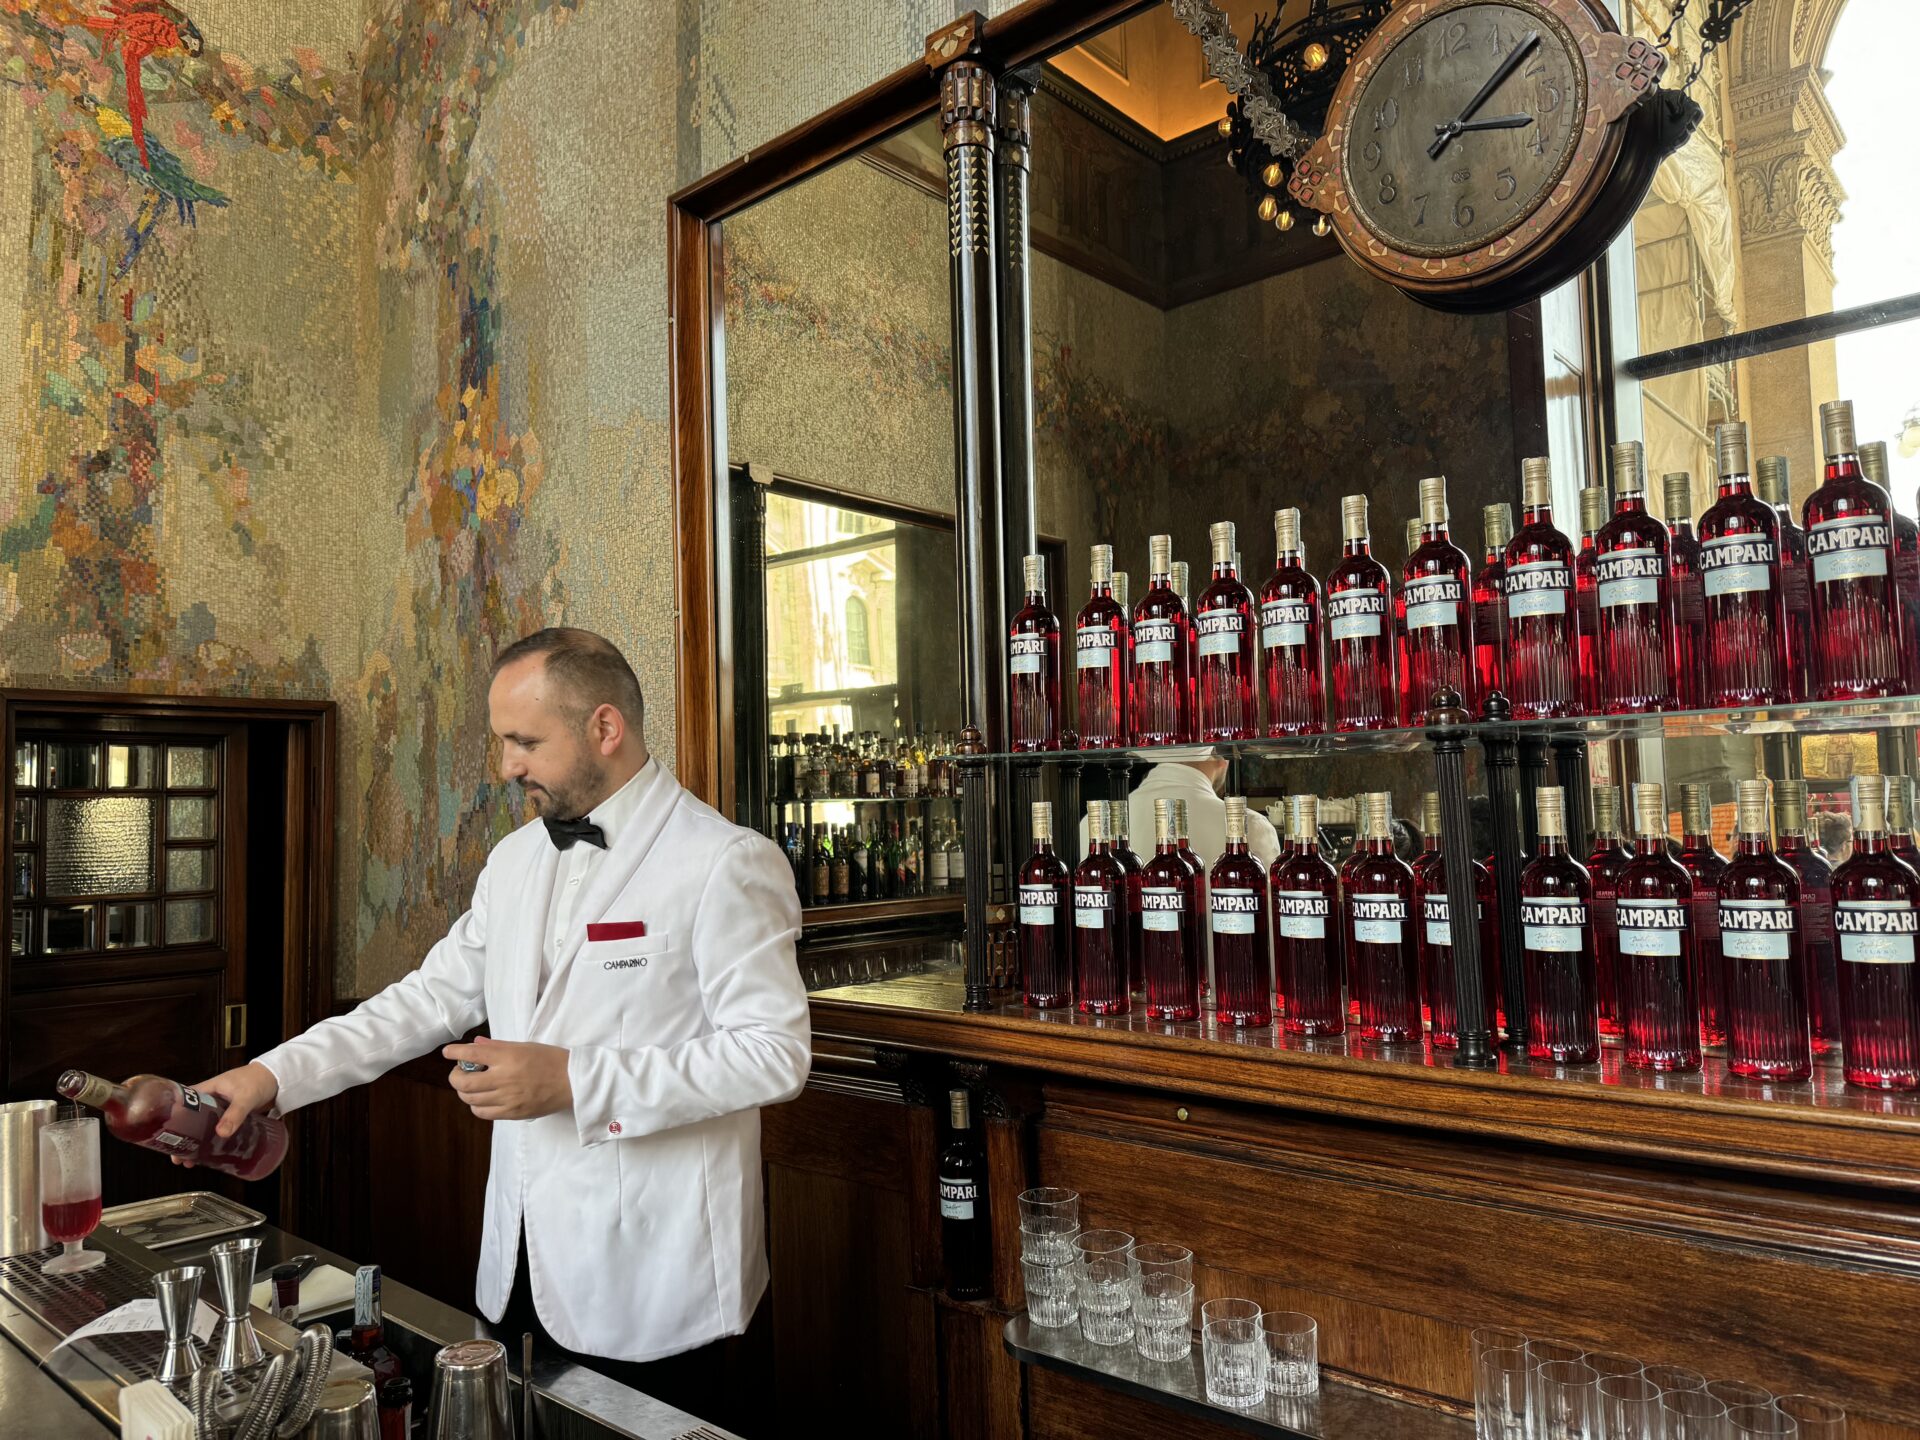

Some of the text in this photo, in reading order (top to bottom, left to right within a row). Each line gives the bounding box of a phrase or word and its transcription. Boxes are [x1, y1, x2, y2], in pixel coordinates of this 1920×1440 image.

[1436, 22, 1471, 61] 12
[1488, 24, 1502, 57] 1
[1535, 77, 1560, 114] 3
[1374, 97, 1399, 133] 10
[1526, 127, 1547, 157] 4
[1362, 140, 1383, 172] 9
[1378, 173, 1397, 206] 8
[1494, 167, 1517, 202] 5
[1413, 193, 1433, 228] 7
[1451, 195, 1475, 228] 6
[1807, 526, 1890, 555] CAMPARI
[1700, 543, 1774, 570] CAMPARI
[1505, 570, 1569, 594] CAMPARI
[1262, 606, 1310, 627] AMPARI
[1328, 597, 1385, 618] CAMPARI
[1136, 626, 1176, 643] AMPARI
[1199, 616, 1243, 635] AMPARI
[1020, 891, 1059, 905] AMPARI
[1142, 895, 1183, 909] AMPARI
[1211, 896, 1259, 911] AMPARI
[1279, 898, 1329, 915] AMPARI
[1521, 906, 1587, 924] CAMPARI
[1616, 908, 1685, 927] CAMPARI
[1718, 910, 1794, 930] CAMPARI
[1834, 911, 1918, 932] CAMPARI
[603, 957, 648, 970] CAMPARINO
[940, 1183, 977, 1200] AMPARI
